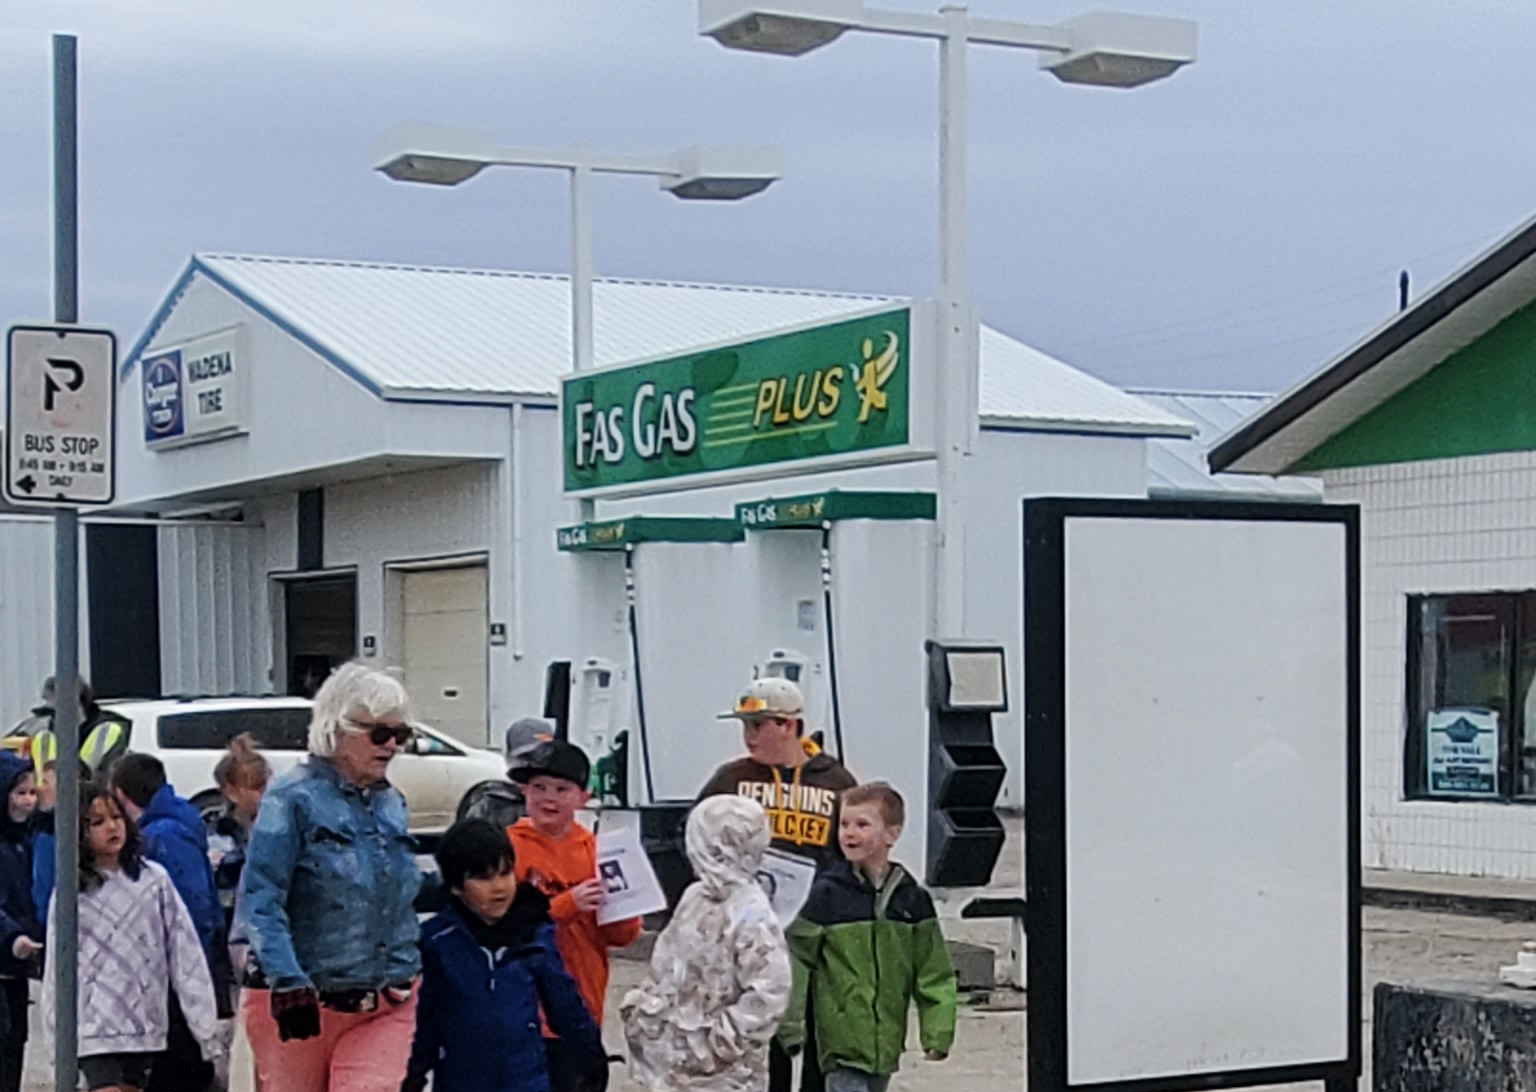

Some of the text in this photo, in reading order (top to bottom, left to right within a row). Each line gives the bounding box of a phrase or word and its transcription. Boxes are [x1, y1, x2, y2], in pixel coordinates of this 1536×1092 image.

[197, 387, 222, 415] TIRE
[575, 366, 843, 466] FAS GAS PLUS
[24, 433, 100, 455] BUS STOP
[738, 782, 835, 816] PENGUINS
[769, 813, 826, 841] OCKEY
